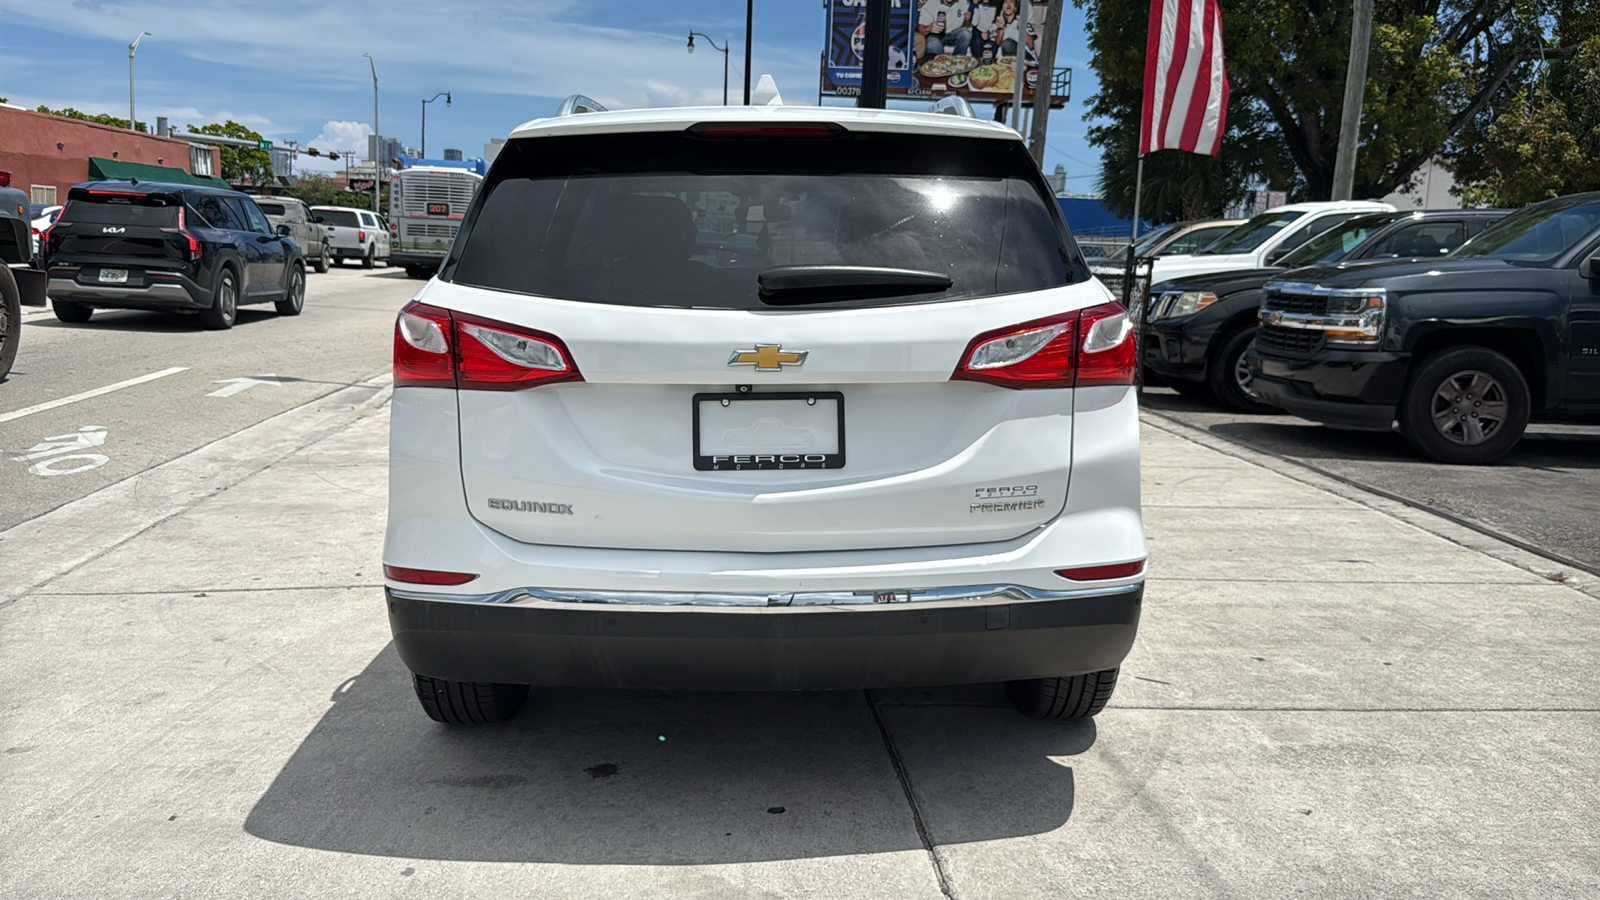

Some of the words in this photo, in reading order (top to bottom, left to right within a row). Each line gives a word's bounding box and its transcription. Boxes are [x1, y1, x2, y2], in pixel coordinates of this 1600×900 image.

[836, 86, 861, 96] 00378
[429, 204, 447, 213] 207
[712, 454, 826, 464] FERCO
[974, 485, 1038, 494] FERCO
[487, 497, 574, 516] EQUINOX
[969, 499, 1046, 514] PREMIER
